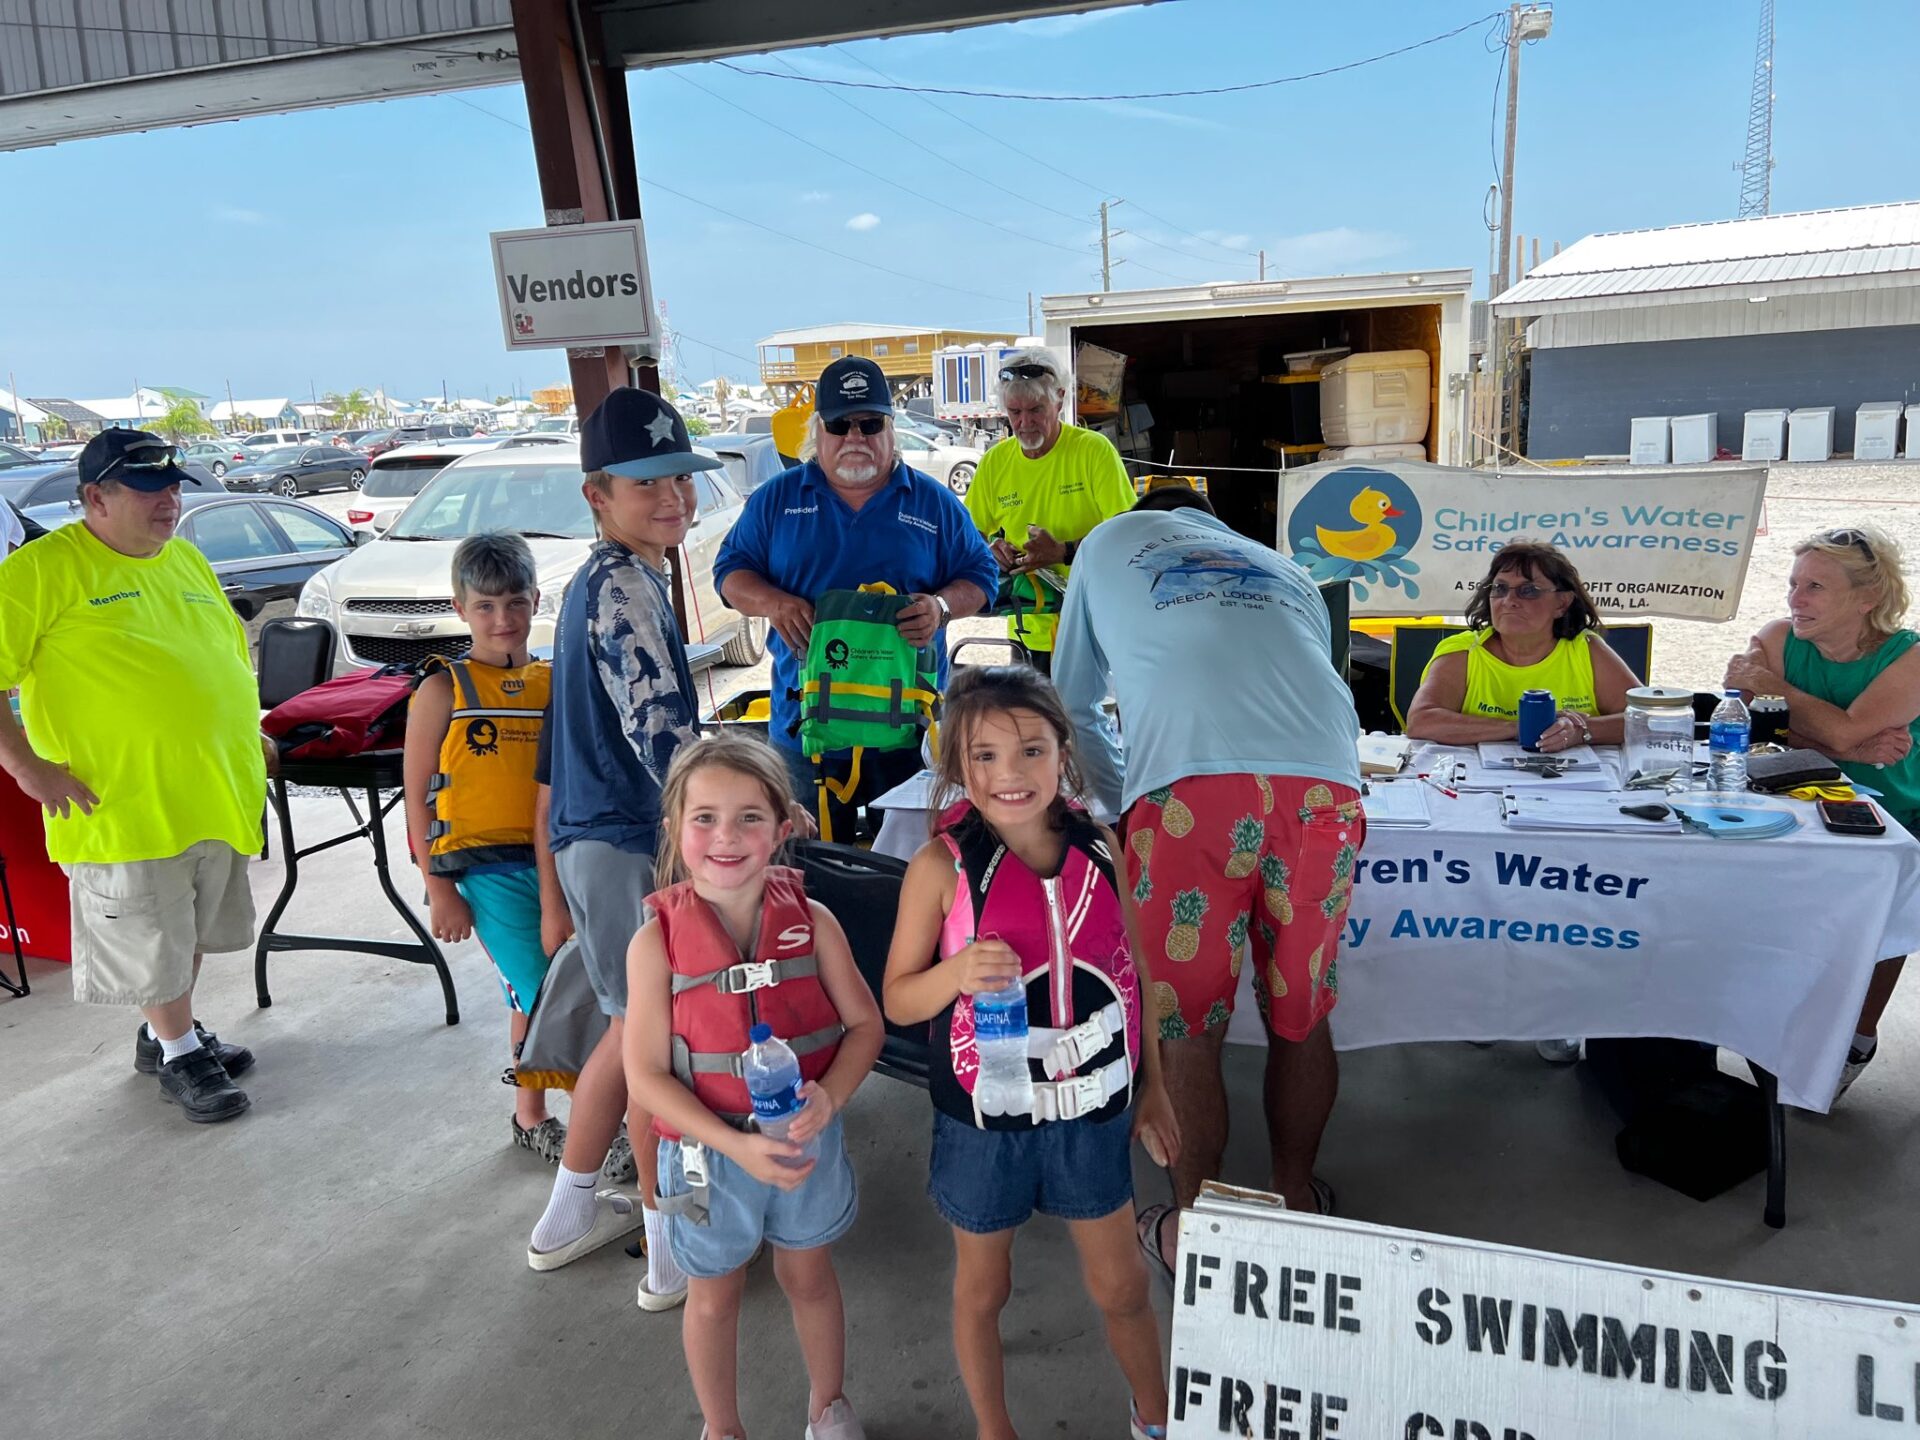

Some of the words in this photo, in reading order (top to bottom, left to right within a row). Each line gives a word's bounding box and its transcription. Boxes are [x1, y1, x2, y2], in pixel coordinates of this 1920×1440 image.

[507, 270, 638, 303] Vendors
[1434, 506, 1609, 532] Children's
[1621, 505, 1745, 530] Water
[1127, 542, 1160, 567] THE
[1432, 533, 1538, 554] Safe
[1550, 531, 1739, 556] Awareness
[89, 590, 141, 606] Member
[1155, 591, 1216, 610] CHEECA
[1222, 591, 1273, 602] LODGE
[1454, 580, 1464, 591] A
[1616, 582, 1725, 600] ORGANIZATION
[1494, 851, 1649, 899] Water
[1390, 909, 1641, 950] Awareness
[1183, 1252, 1362, 1334] FREE
[1415, 1286, 1788, 1401] SWIMMING
[1174, 1366, 1348, 1440] FREE
